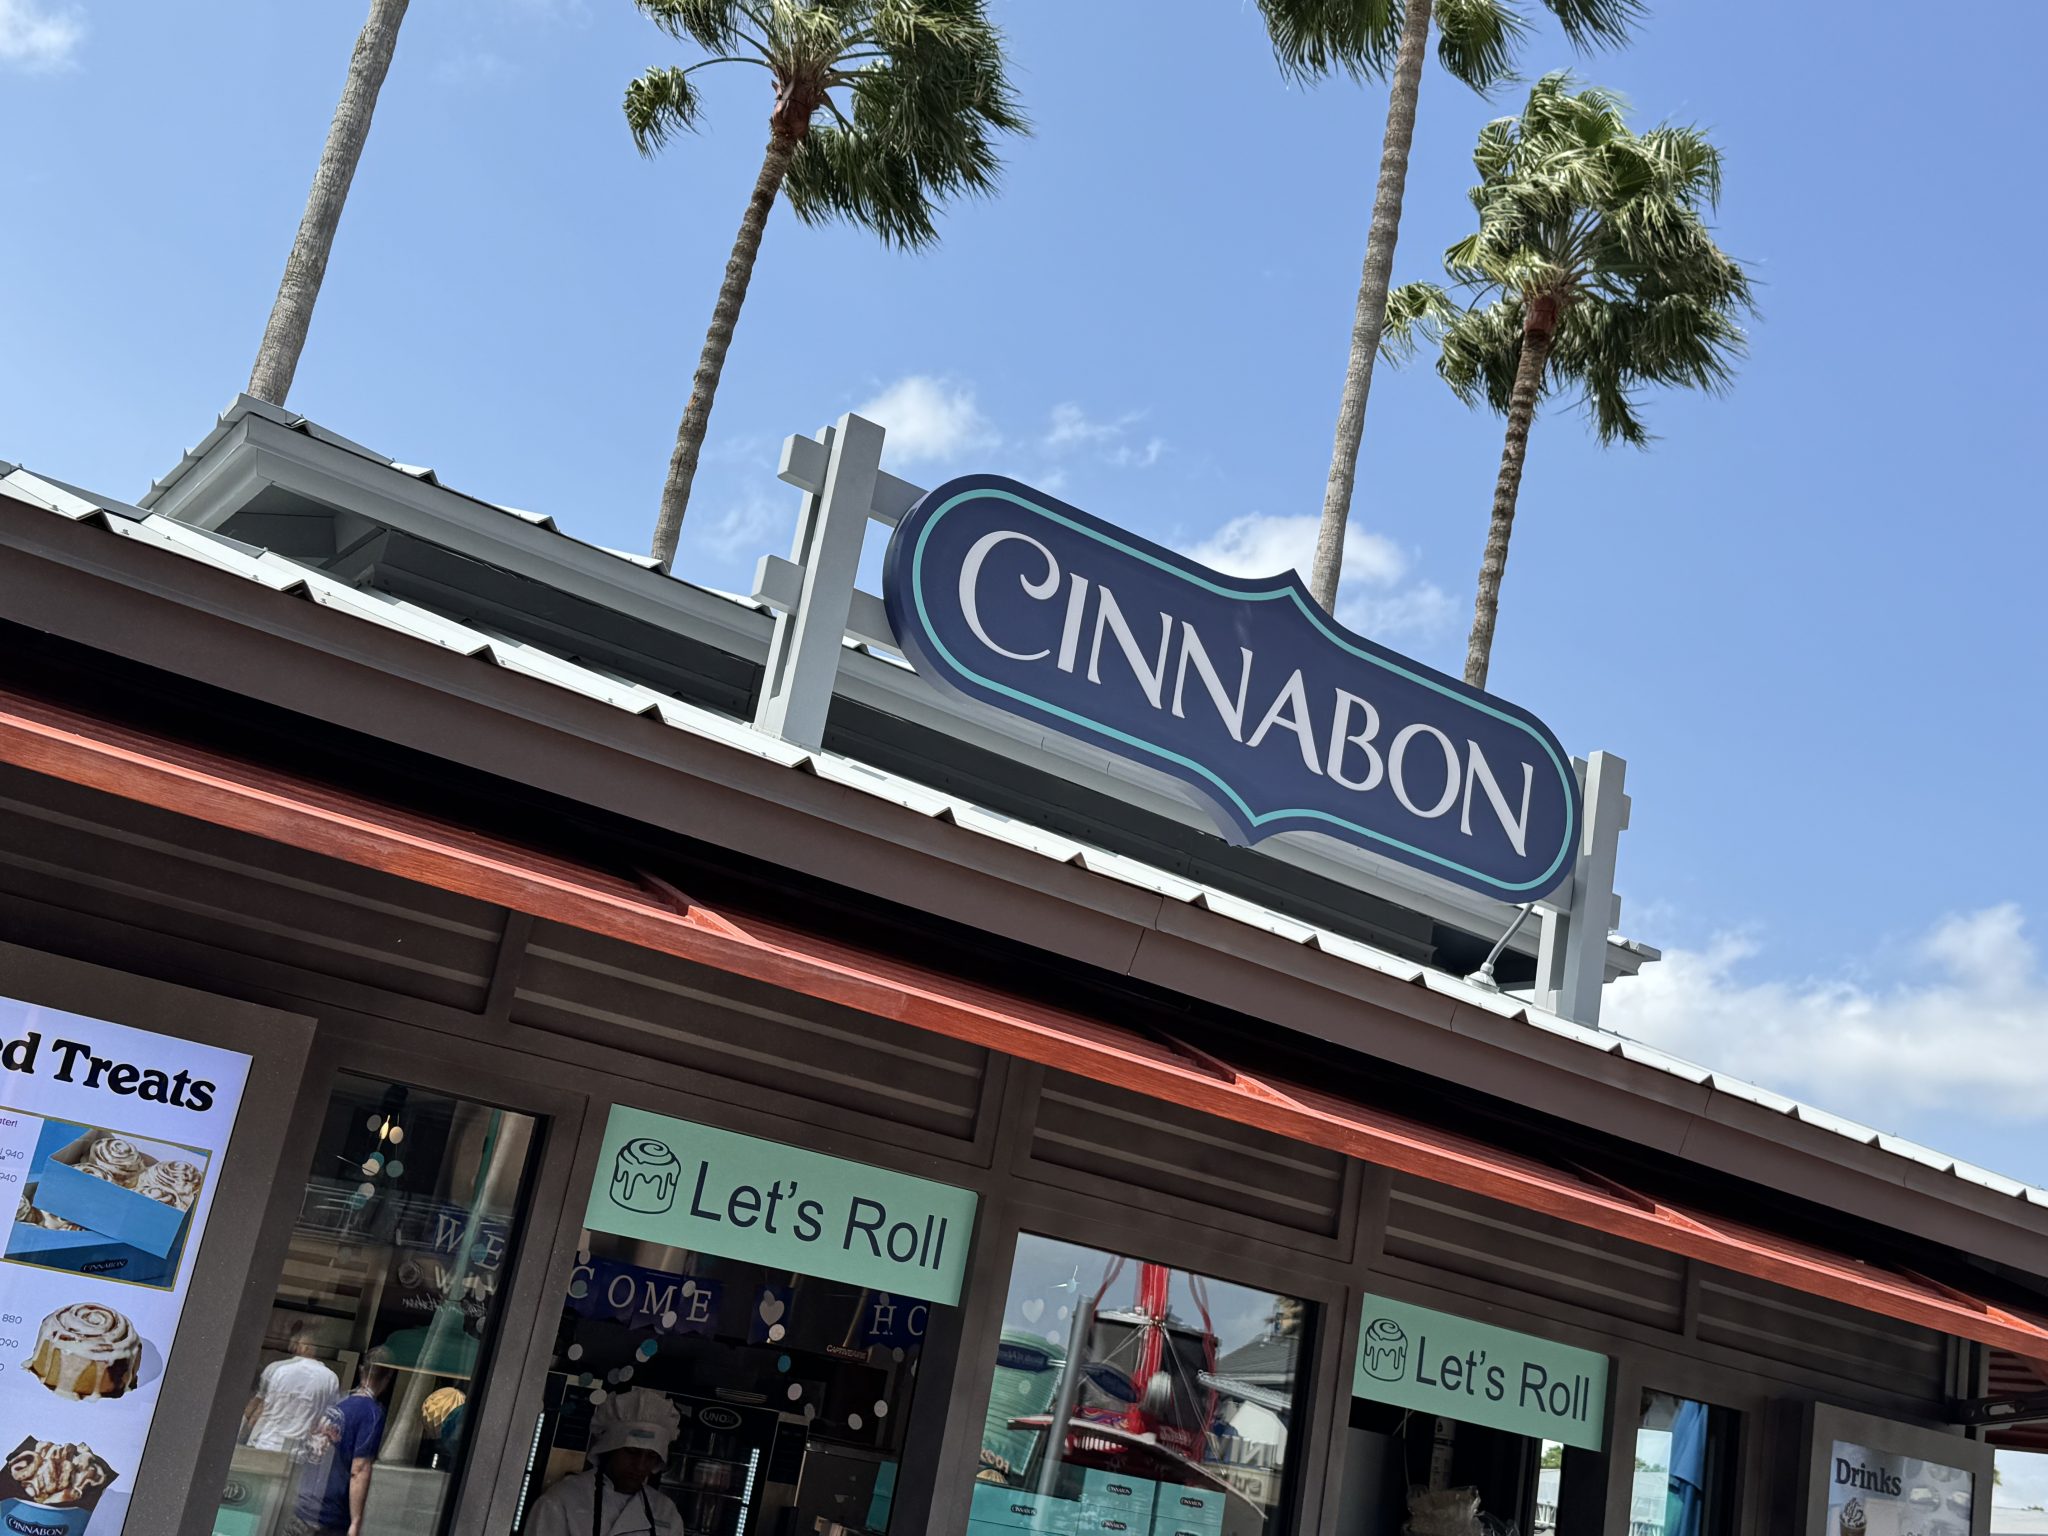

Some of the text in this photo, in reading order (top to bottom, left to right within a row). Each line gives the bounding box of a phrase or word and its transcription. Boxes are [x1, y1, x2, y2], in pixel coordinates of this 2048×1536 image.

[958, 530, 1534, 858] CINNABON
[0, 1032, 216, 1112] d Treats
[5, 1149, 25, 1160] 940
[690, 1160, 948, 1270] Let's Roll
[1416, 1336, 1590, 1422] Let's Roll
[1834, 1457, 1902, 1497] Drinks
[8, 1517, 64, 1536] CINNABON
